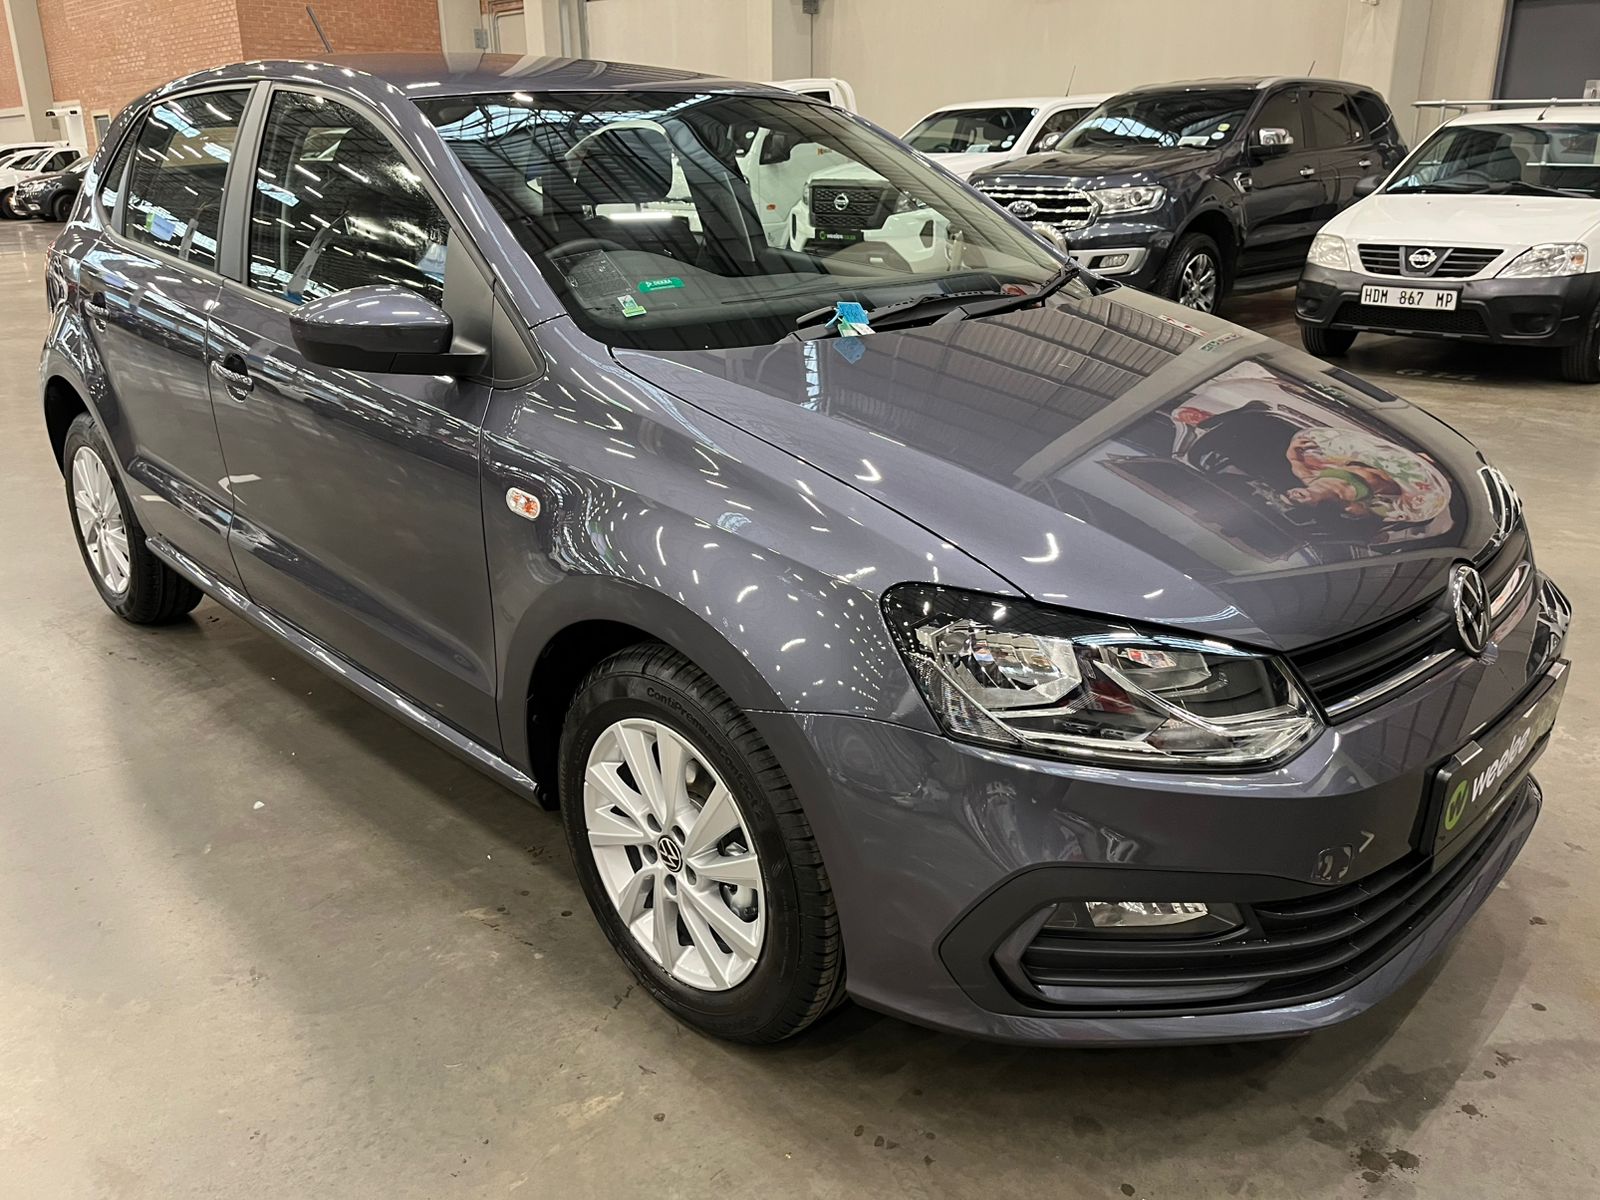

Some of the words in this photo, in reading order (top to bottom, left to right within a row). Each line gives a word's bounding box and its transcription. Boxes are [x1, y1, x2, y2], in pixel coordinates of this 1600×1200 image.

[1364, 287, 1389, 304] HDM
[1399, 290, 1424, 306] 867
[1435, 292, 1453, 308] MP
